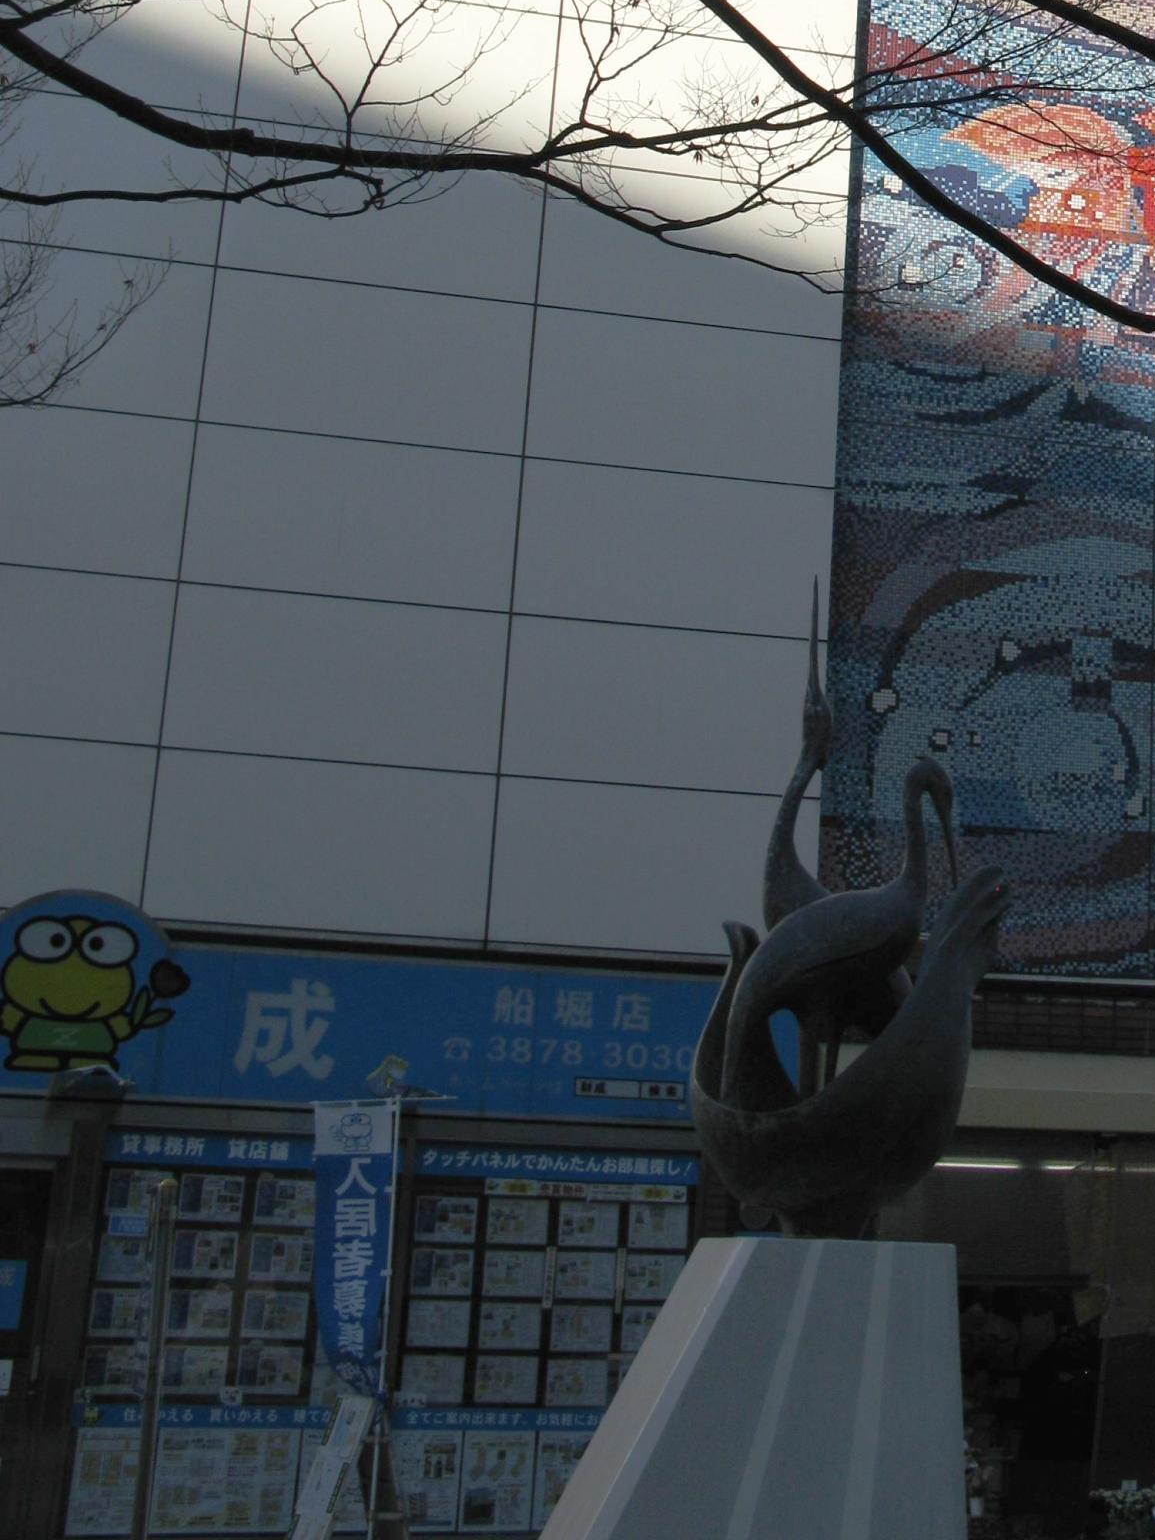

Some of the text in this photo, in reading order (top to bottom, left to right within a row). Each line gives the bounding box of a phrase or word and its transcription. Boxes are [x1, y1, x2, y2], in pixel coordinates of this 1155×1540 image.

[234, 978, 337, 1081] 成
[494, 984, 651, 1032] 船堀店
[120, 1133, 290, 1161] 貸事務所 貸店舗
